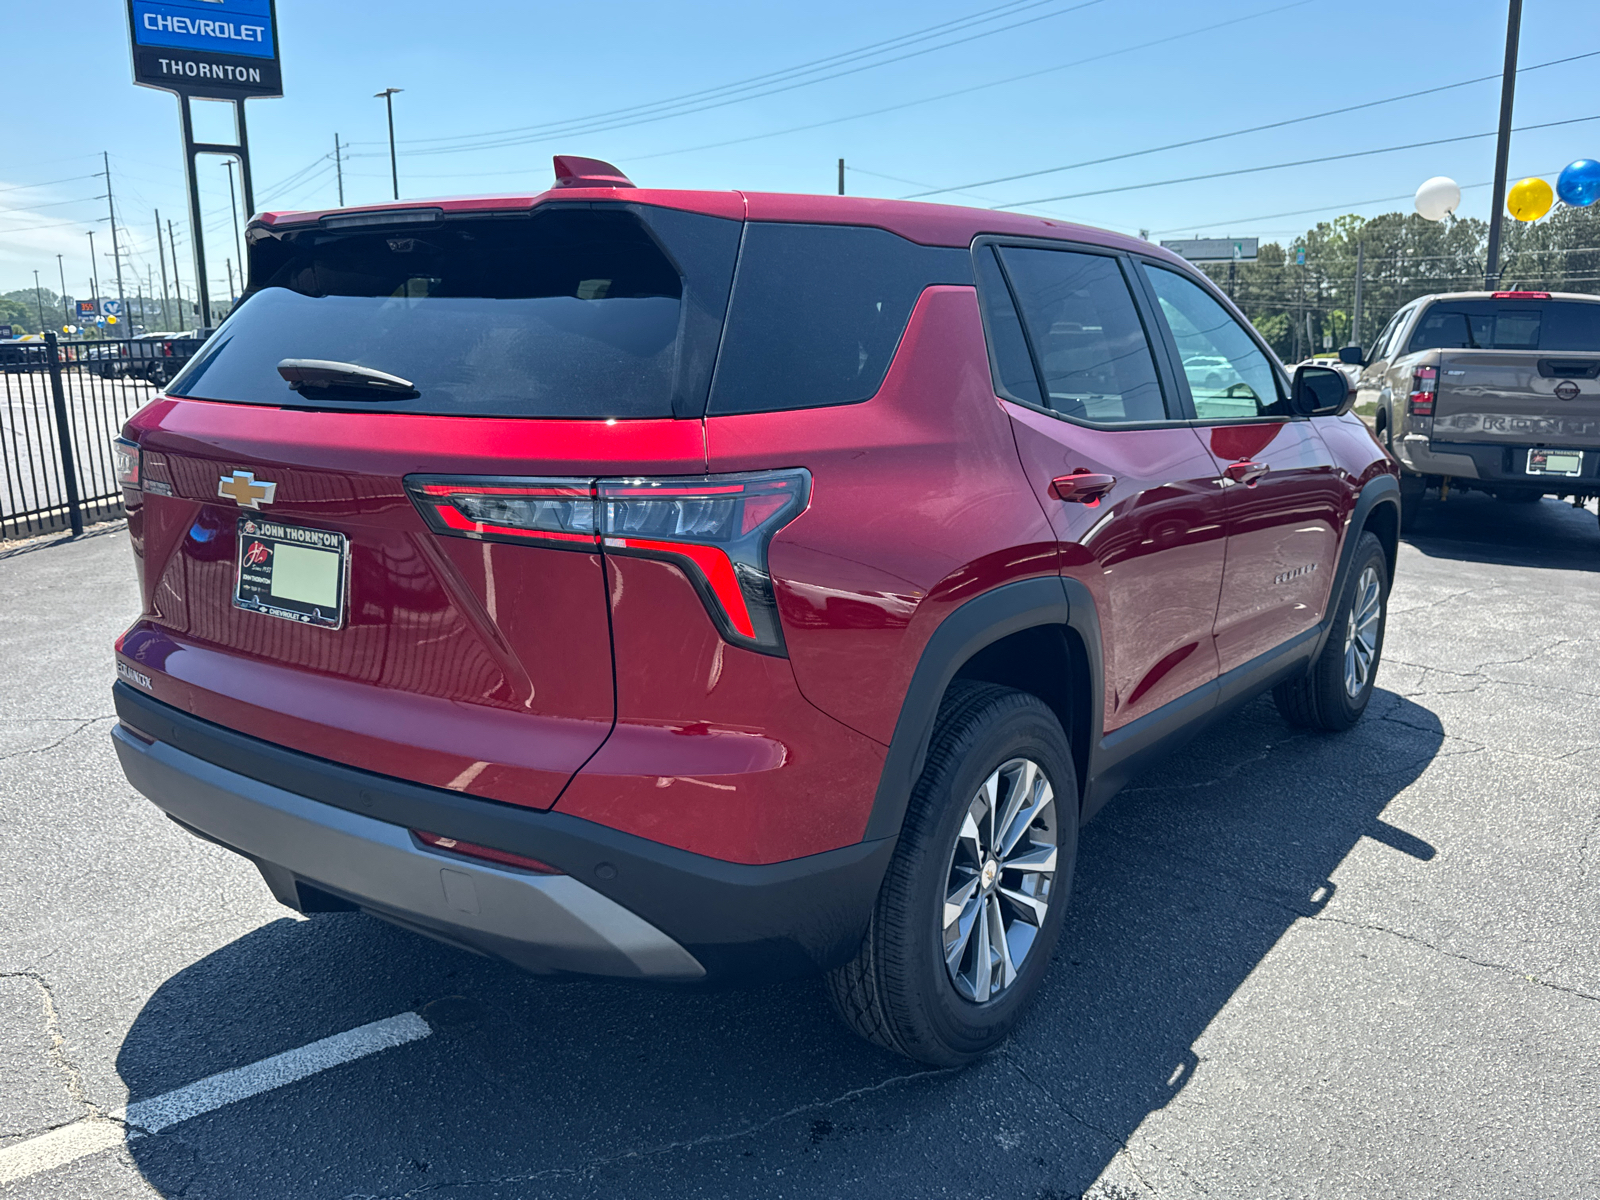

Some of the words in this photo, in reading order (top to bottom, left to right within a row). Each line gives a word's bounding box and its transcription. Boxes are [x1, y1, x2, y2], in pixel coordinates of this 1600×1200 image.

[143, 12, 266, 42] CHEVROLET
[158, 58, 261, 83] THORNTON
[260, 523, 284, 538] JOHN
[286, 528, 338, 547] THORNTON
[269, 608, 300, 620] CHEVROLET
